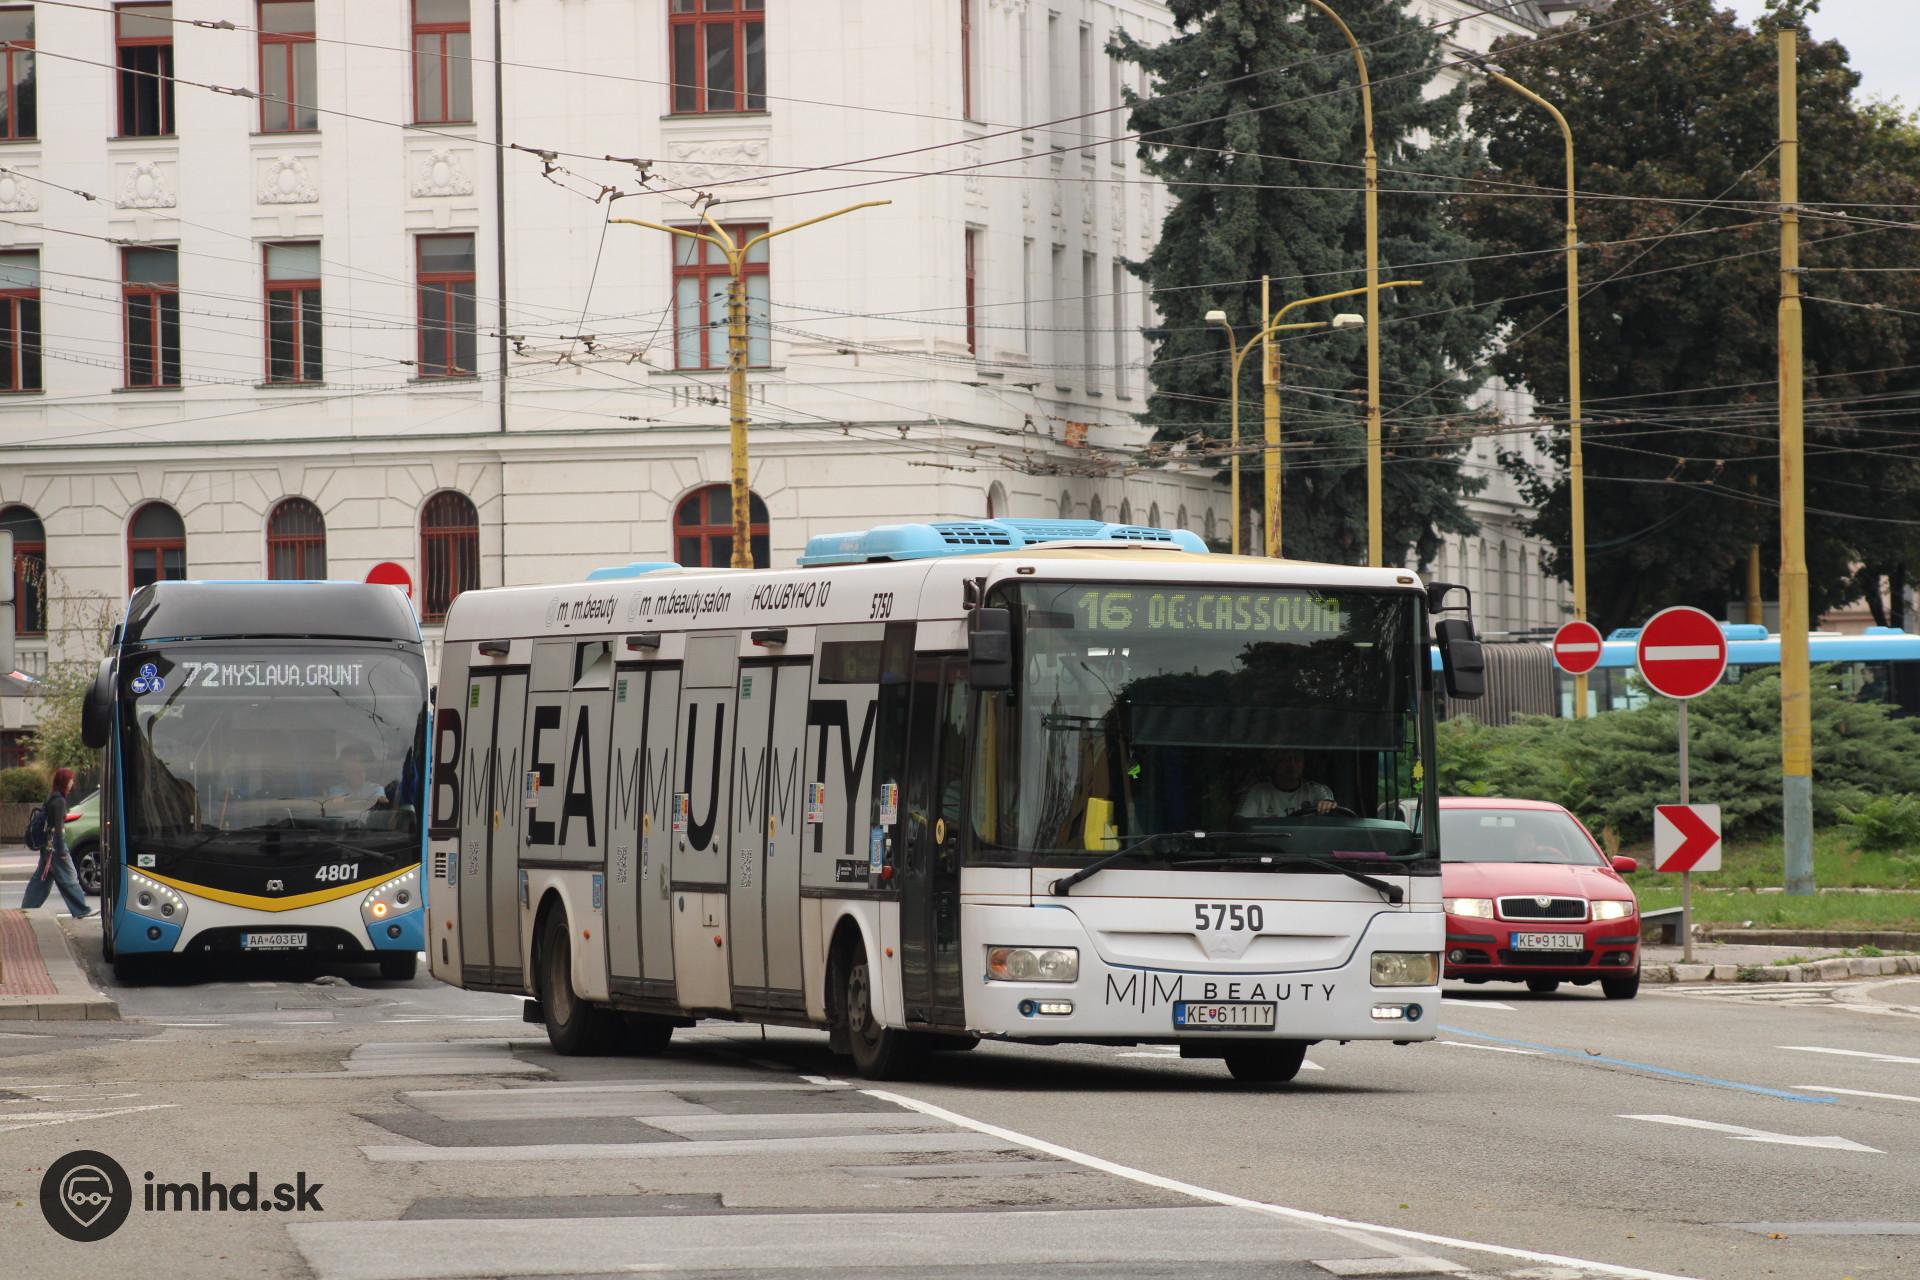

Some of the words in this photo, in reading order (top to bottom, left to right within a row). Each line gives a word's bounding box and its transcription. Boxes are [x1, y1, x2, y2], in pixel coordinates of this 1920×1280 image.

[752, 582, 816, 610] HOLUBYHO
[816, 581, 831, 607] 10
[870, 592, 893, 619] 5750
[1078, 592, 1133, 630] 16
[1196, 595, 1341, 632] CASSOVIA
[182, 662, 220, 687] 72
[315, 863, 359, 882] 4801
[1195, 904, 1264, 932] 5750
[1204, 982, 1336, 1001] BEAUTY
[1187, 1005, 1208, 1023] KE
